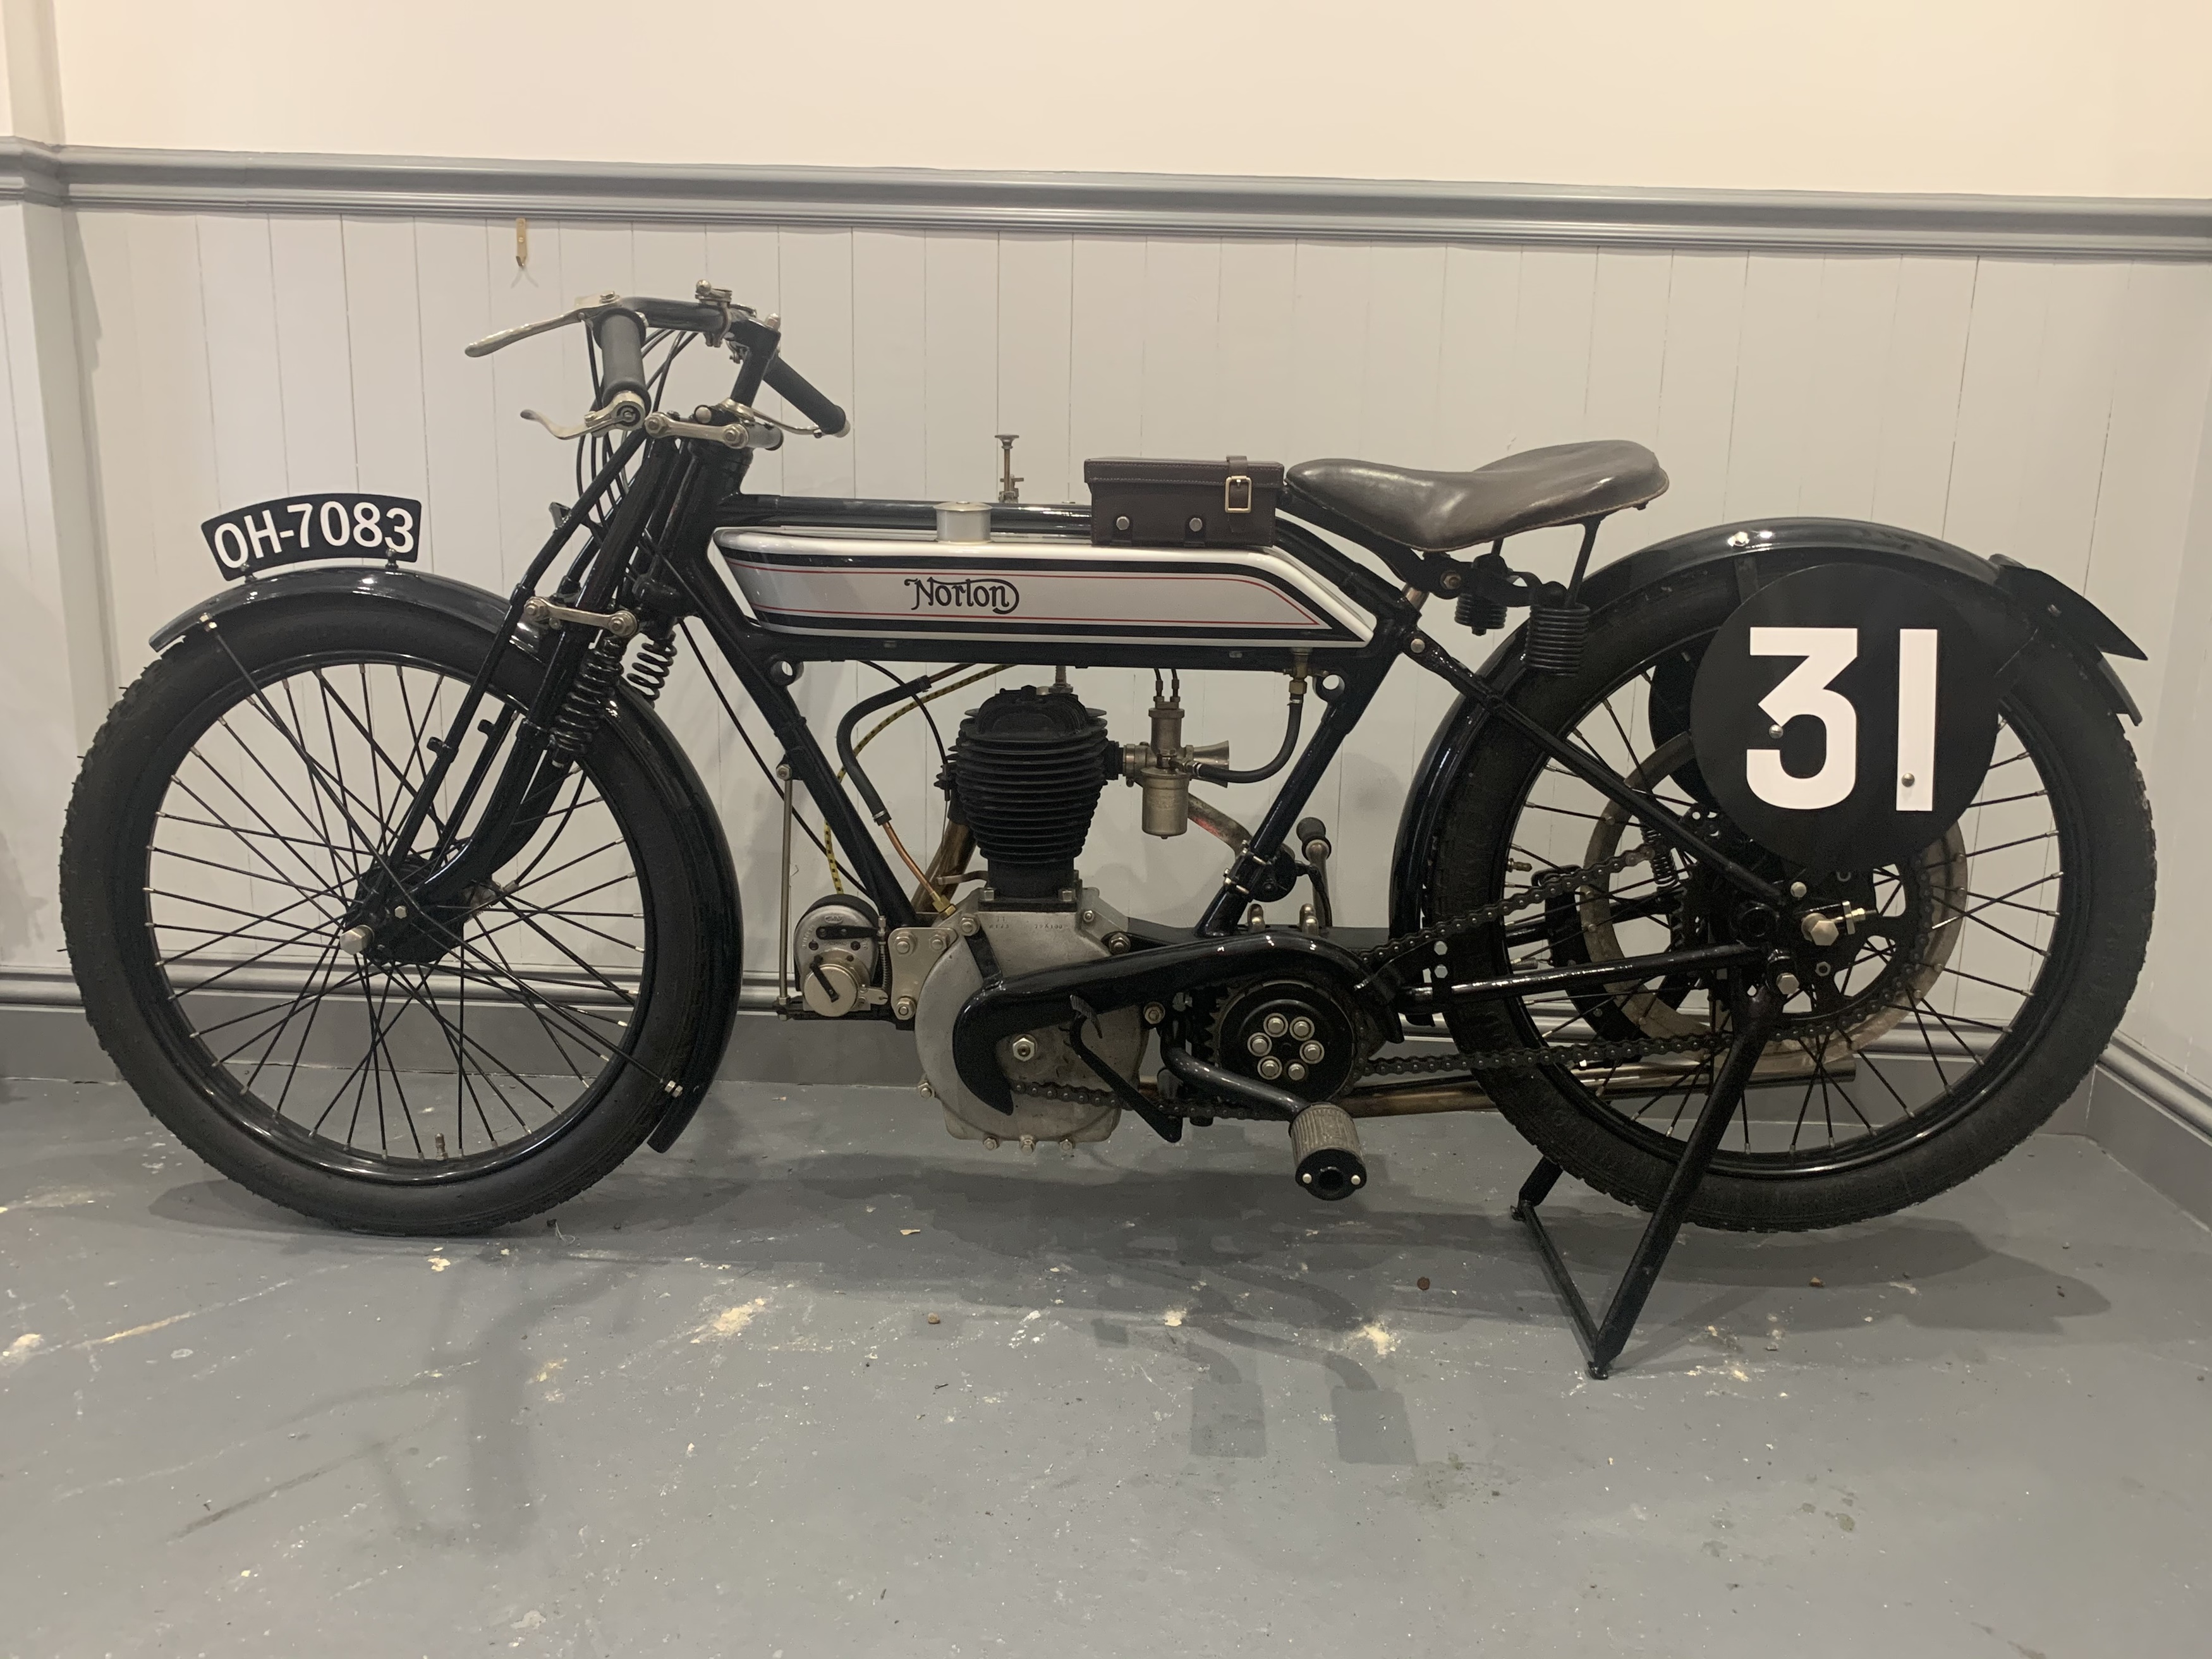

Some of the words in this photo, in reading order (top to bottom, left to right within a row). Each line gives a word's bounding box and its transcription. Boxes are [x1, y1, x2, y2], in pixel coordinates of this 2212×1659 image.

[214, 501, 414, 568] OH-7083
[904, 576, 1019, 614] Norton
[1746, 627, 1937, 811] 31
